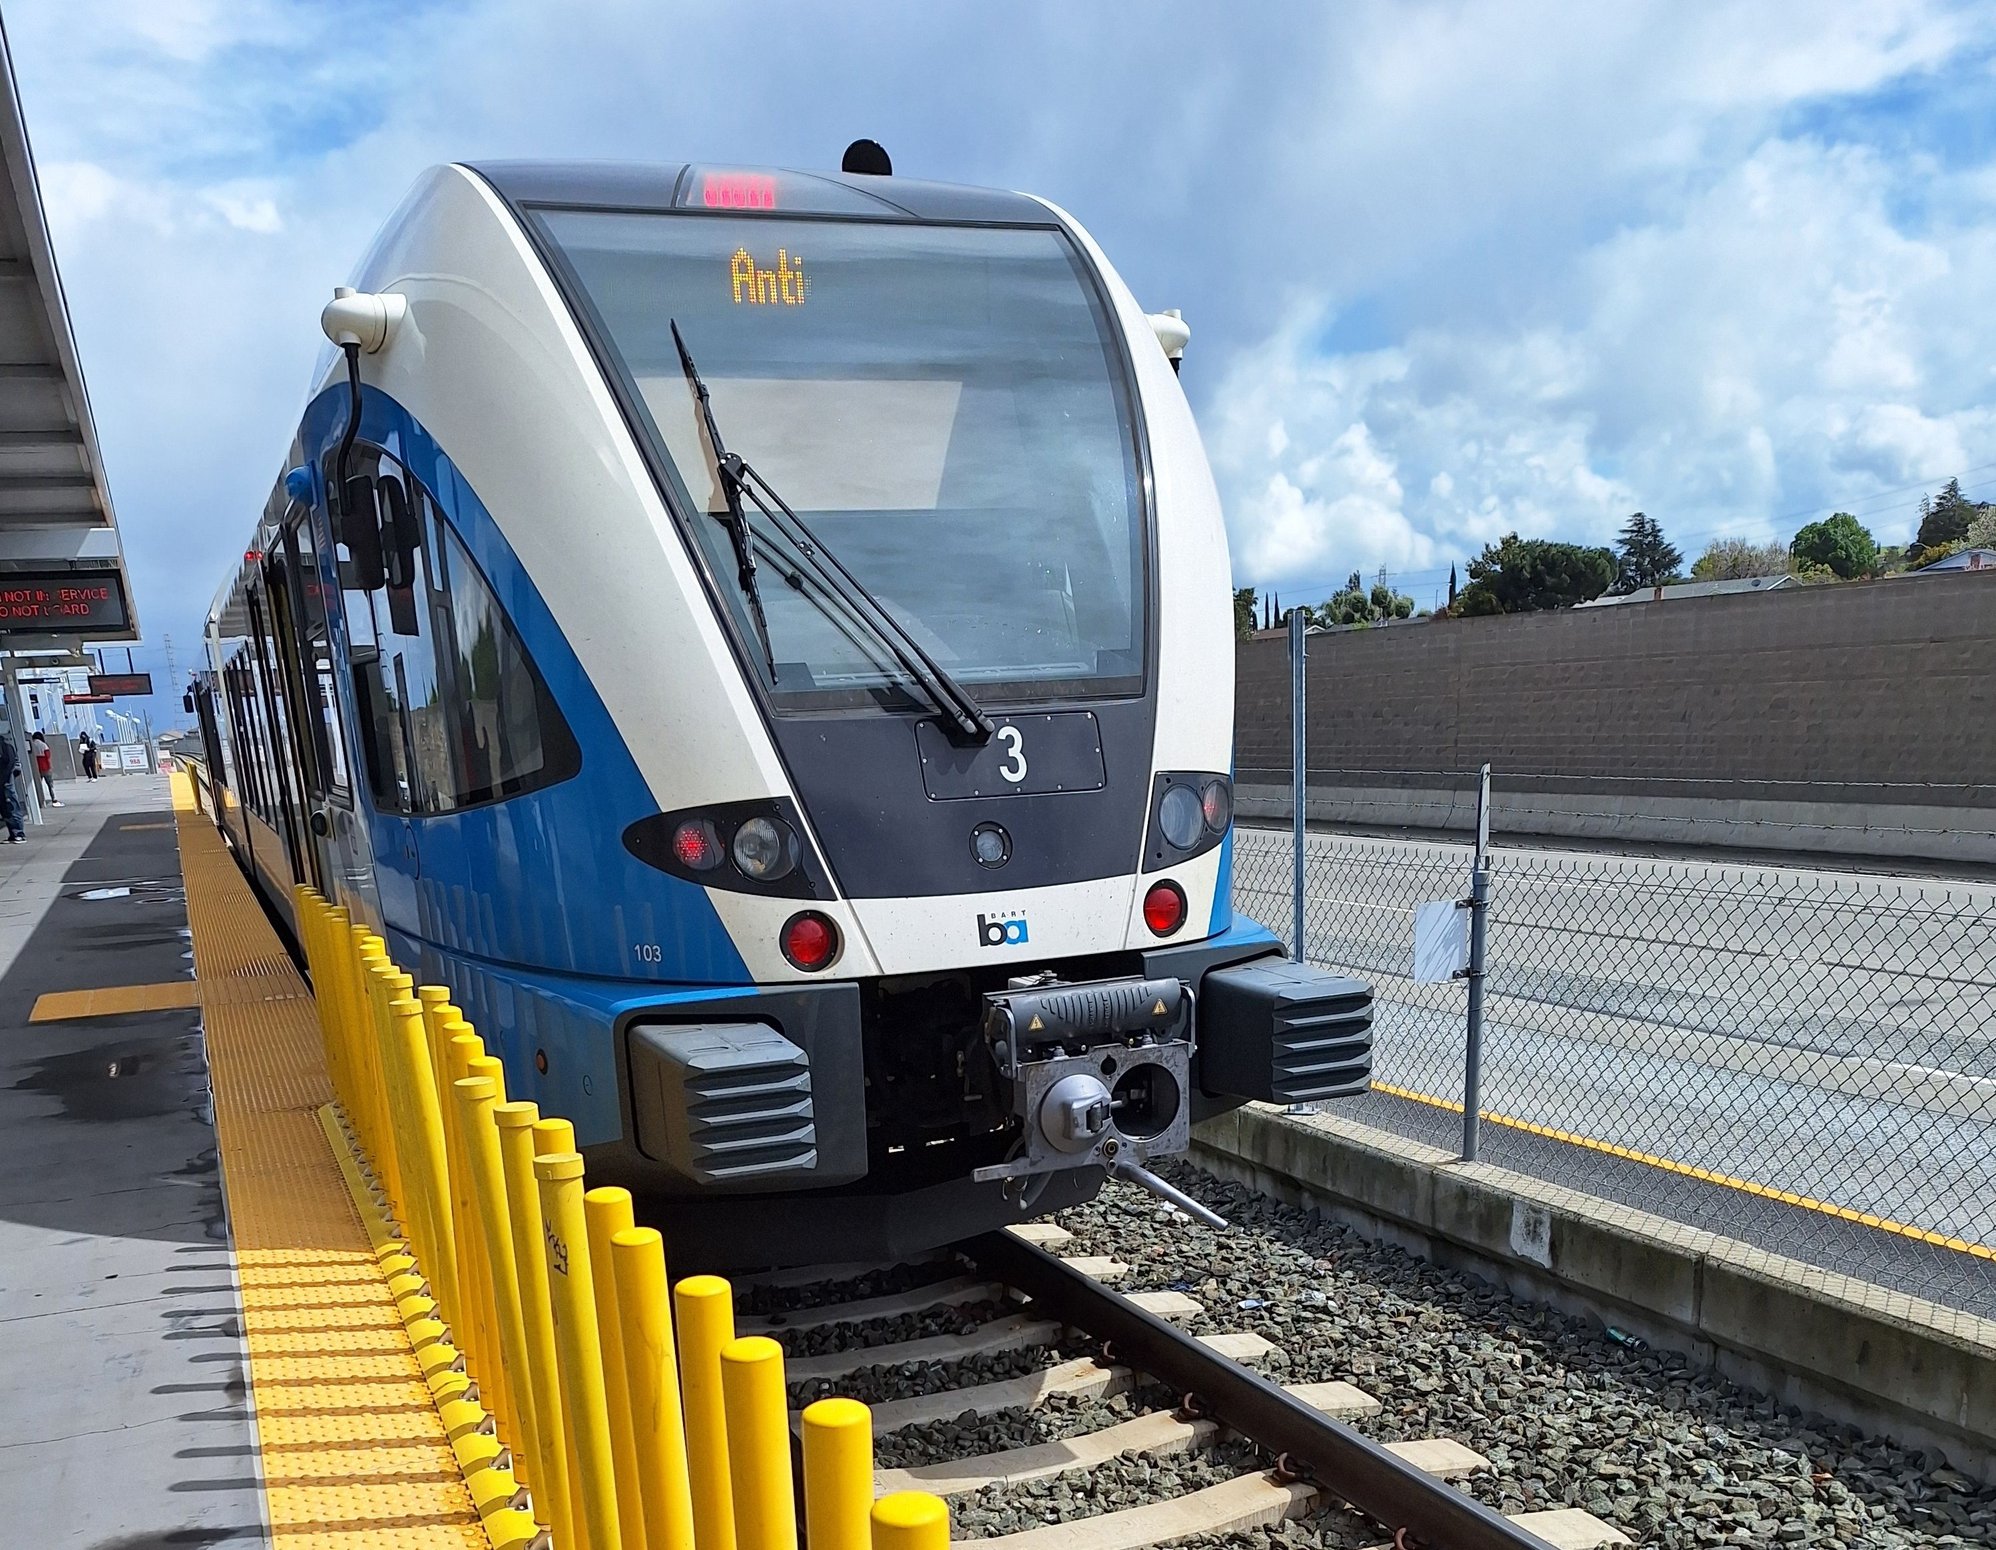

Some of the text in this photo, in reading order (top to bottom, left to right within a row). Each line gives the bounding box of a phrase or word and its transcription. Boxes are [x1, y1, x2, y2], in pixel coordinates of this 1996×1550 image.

[731, 247, 804, 304] Anti
[4, 590, 31, 602] NOT
[58, 587, 108, 601] ERVICE
[0, 606, 8, 617] O
[12, 604, 39, 617] NOT
[997, 725, 1028, 783] 3
[990, 909, 1027, 919] BART
[634, 944, 662, 962] 103
